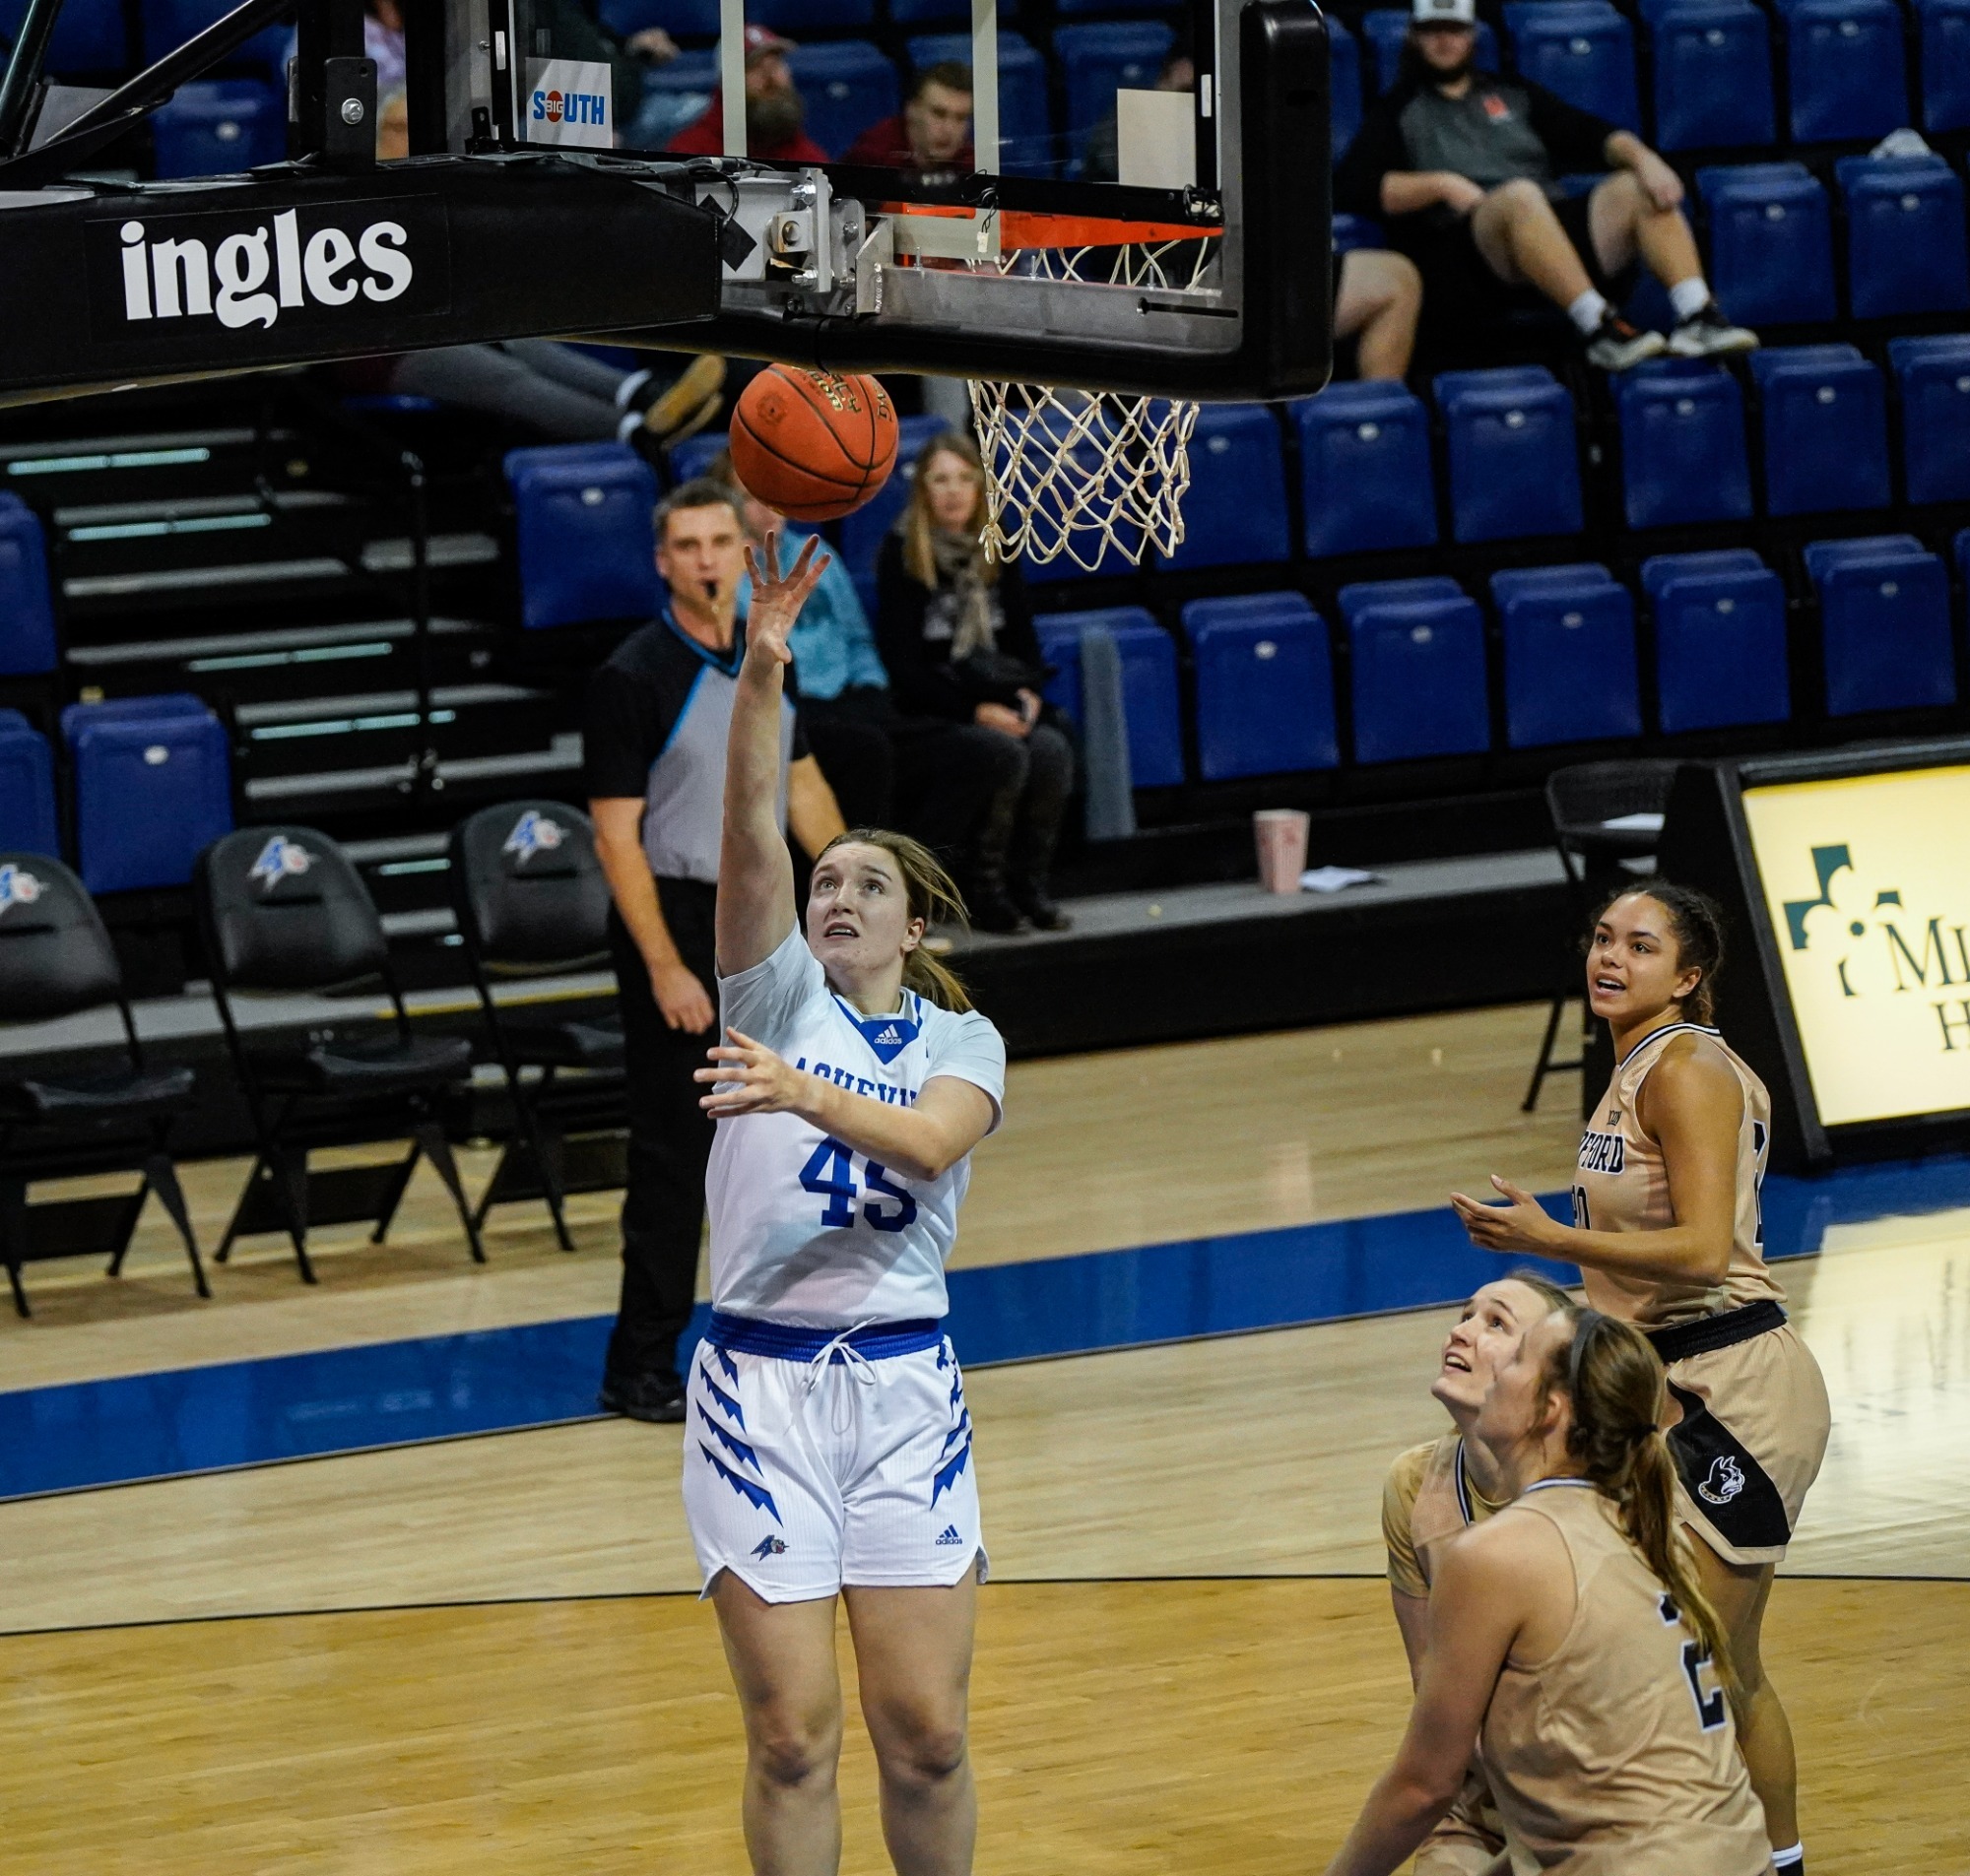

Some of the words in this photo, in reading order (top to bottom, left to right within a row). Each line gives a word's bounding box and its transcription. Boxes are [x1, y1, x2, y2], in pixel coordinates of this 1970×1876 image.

[120, 208, 413, 329] ingles
[874, 1036, 902, 1045] adidas
[798, 1134, 917, 1233] 45
[936, 1536, 963, 1545] adidas
